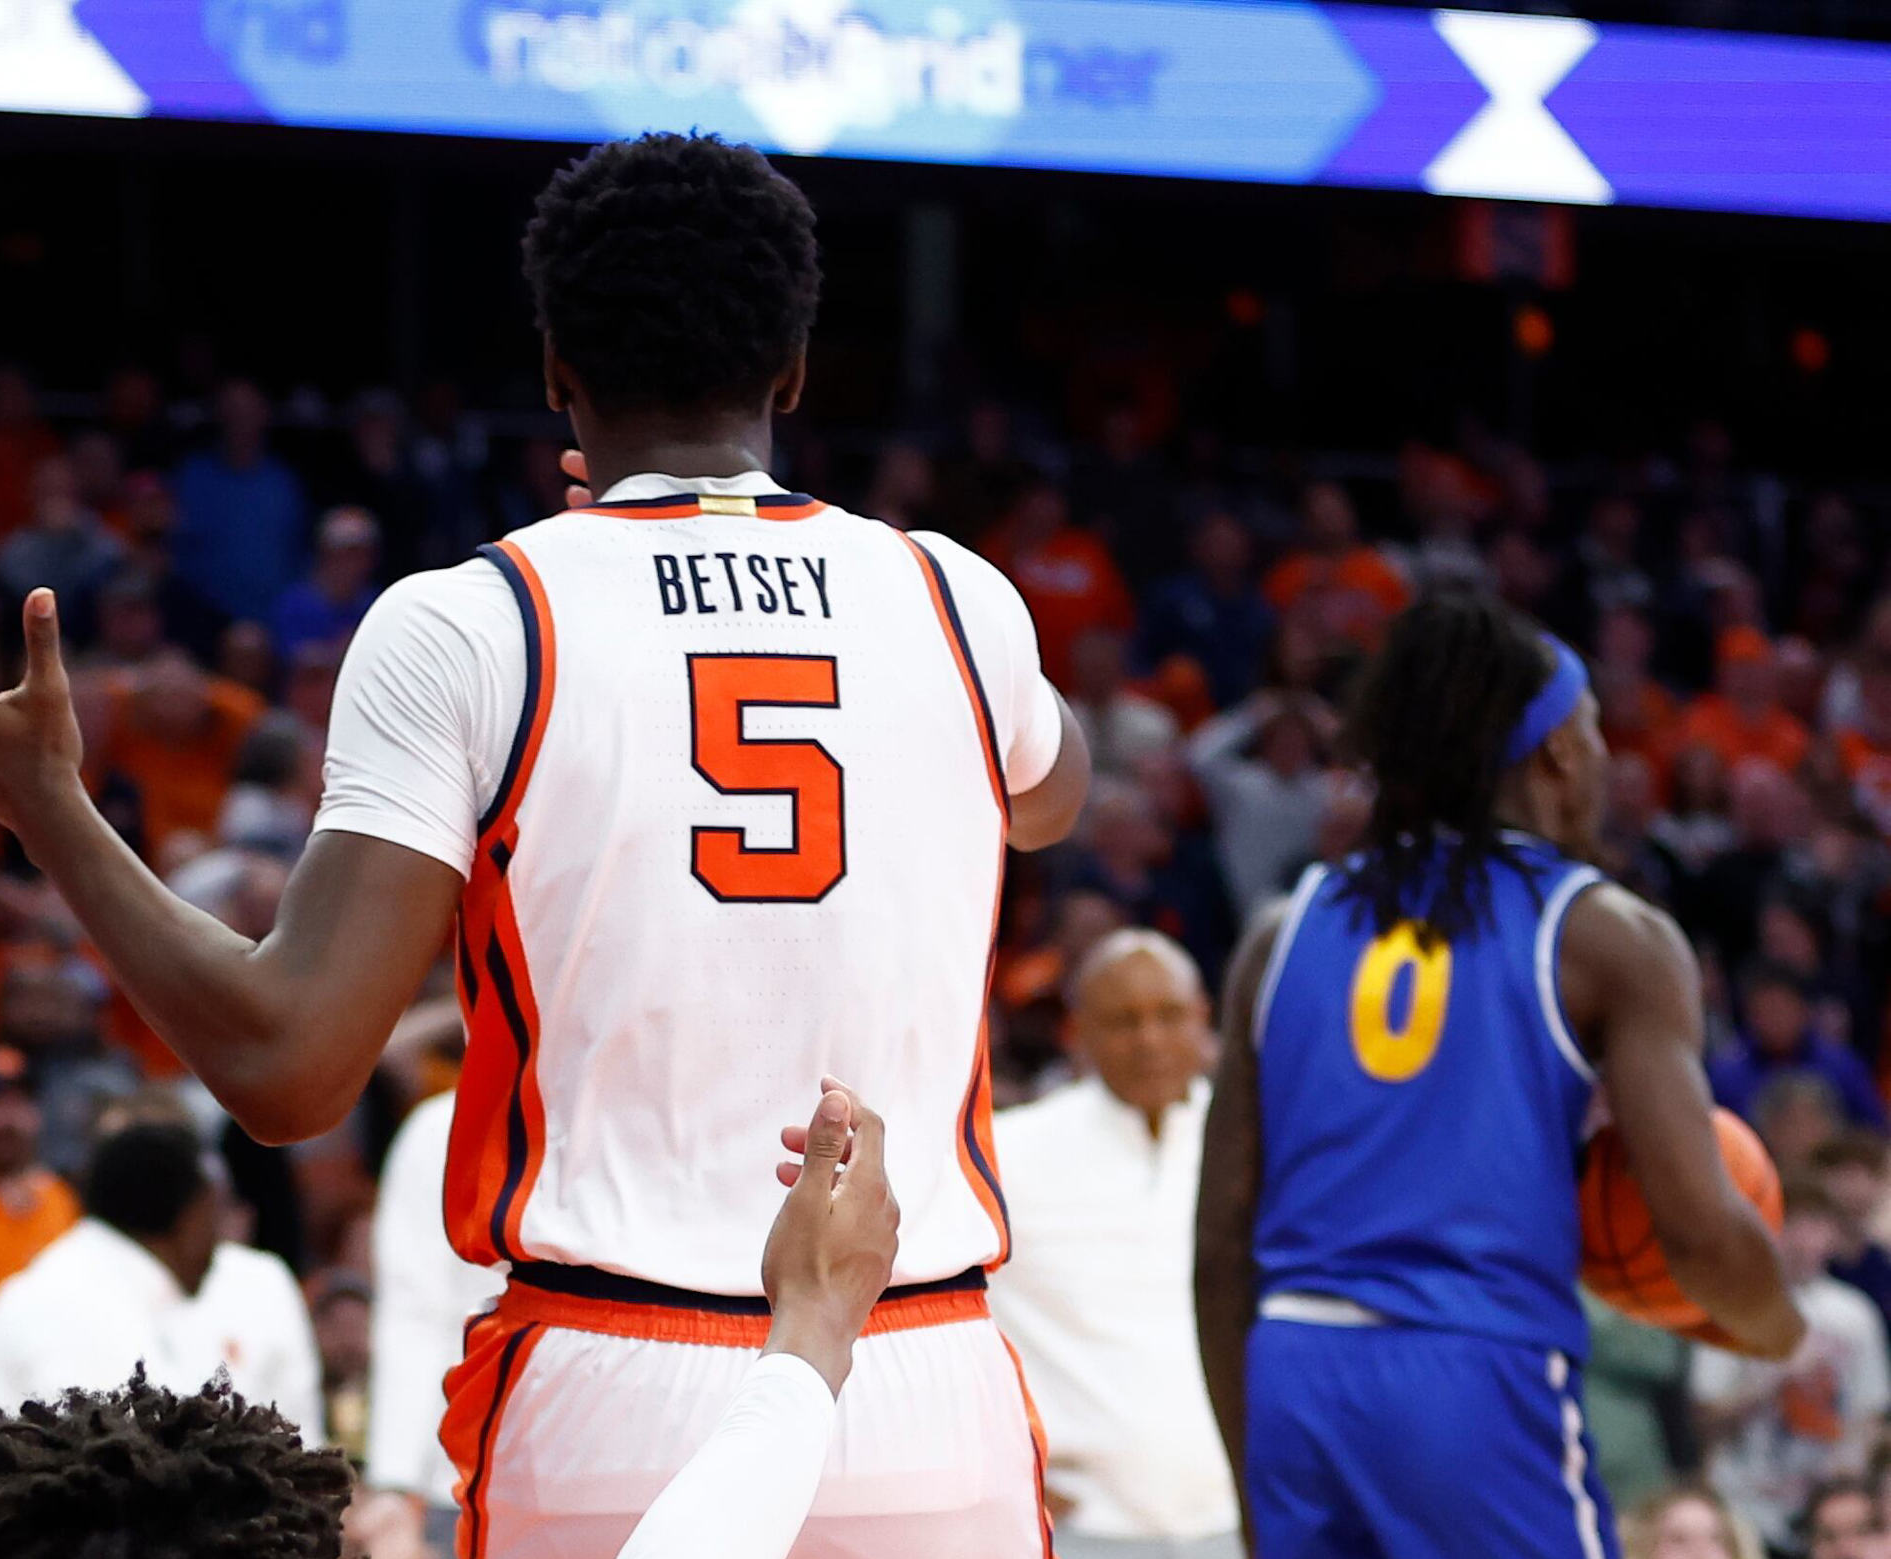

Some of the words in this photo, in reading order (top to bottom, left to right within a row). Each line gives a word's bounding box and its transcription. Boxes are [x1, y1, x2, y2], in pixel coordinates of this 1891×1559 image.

[654, 553, 833, 618] BETSEY
[686, 653, 847, 903] 5
[1349, 918, 1453, 1082] 0
